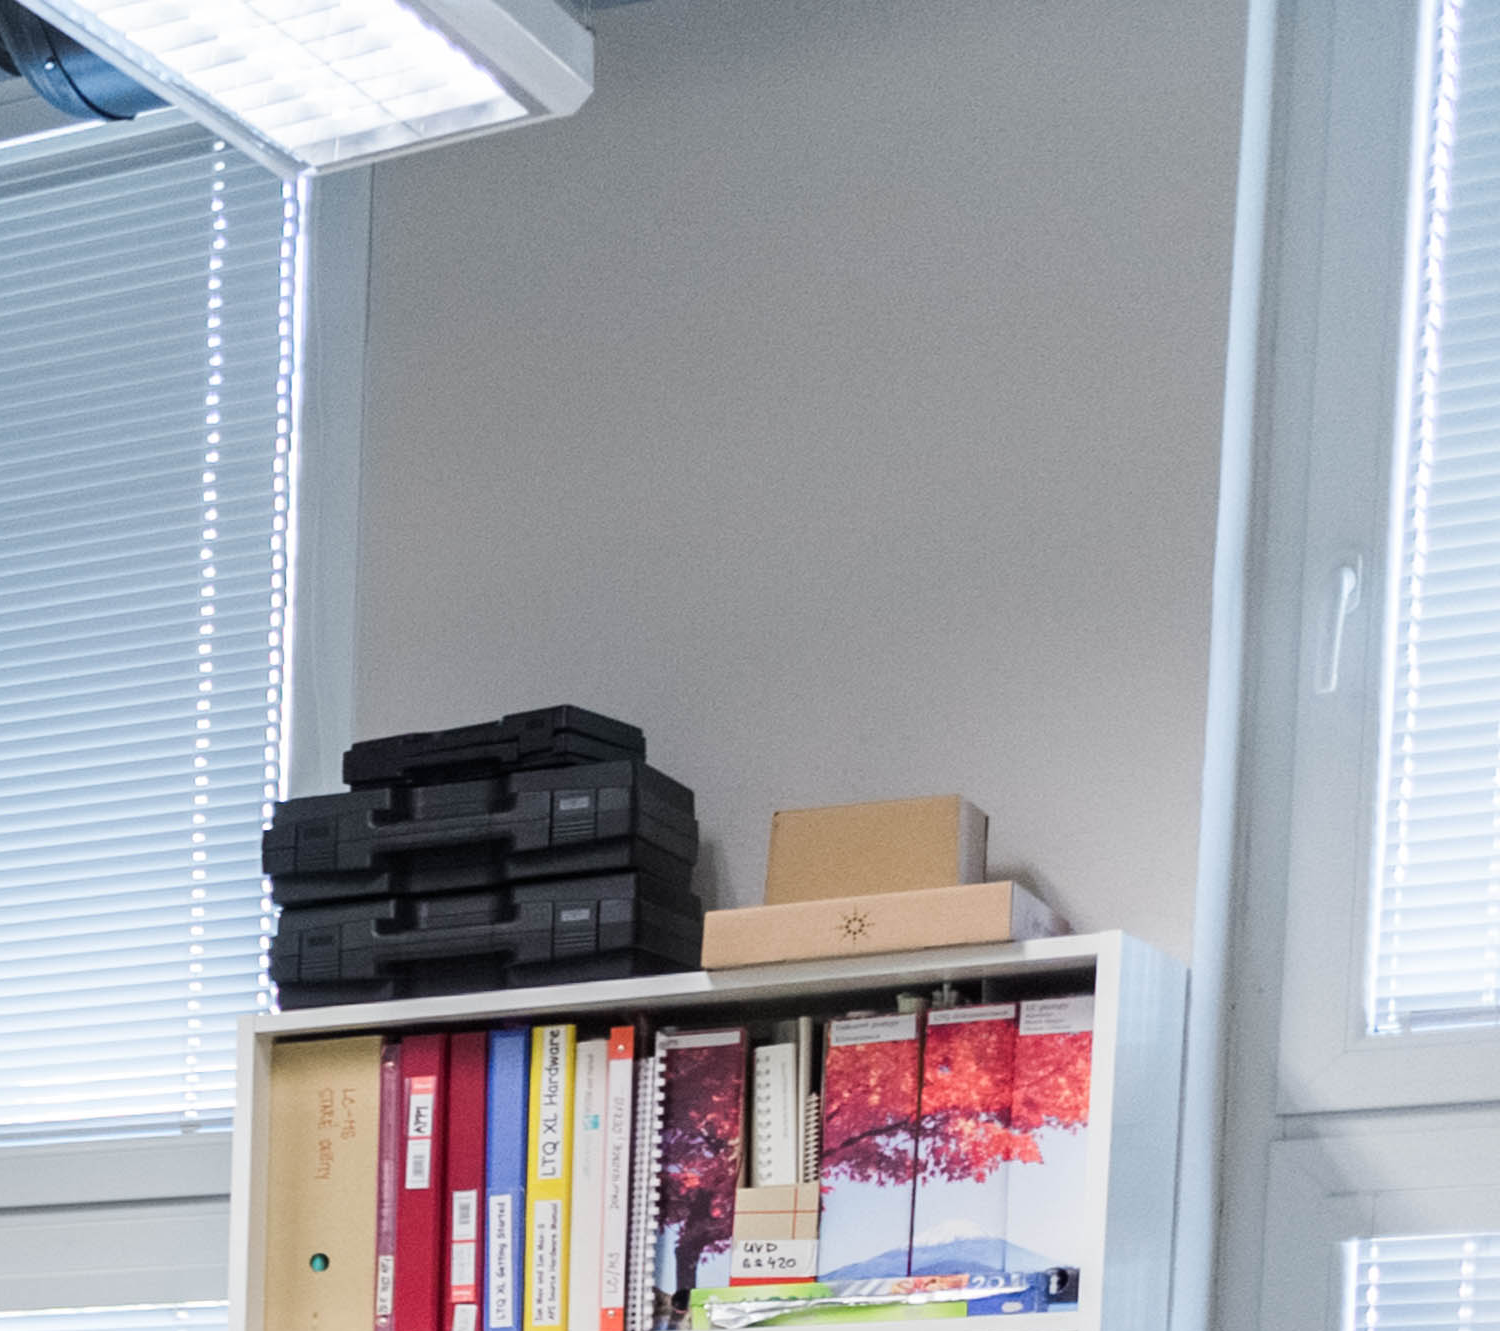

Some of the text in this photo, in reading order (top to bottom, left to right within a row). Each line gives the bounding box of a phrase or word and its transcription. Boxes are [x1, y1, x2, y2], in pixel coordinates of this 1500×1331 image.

[541, 1029, 561, 1177] LTQ XL Hardware
